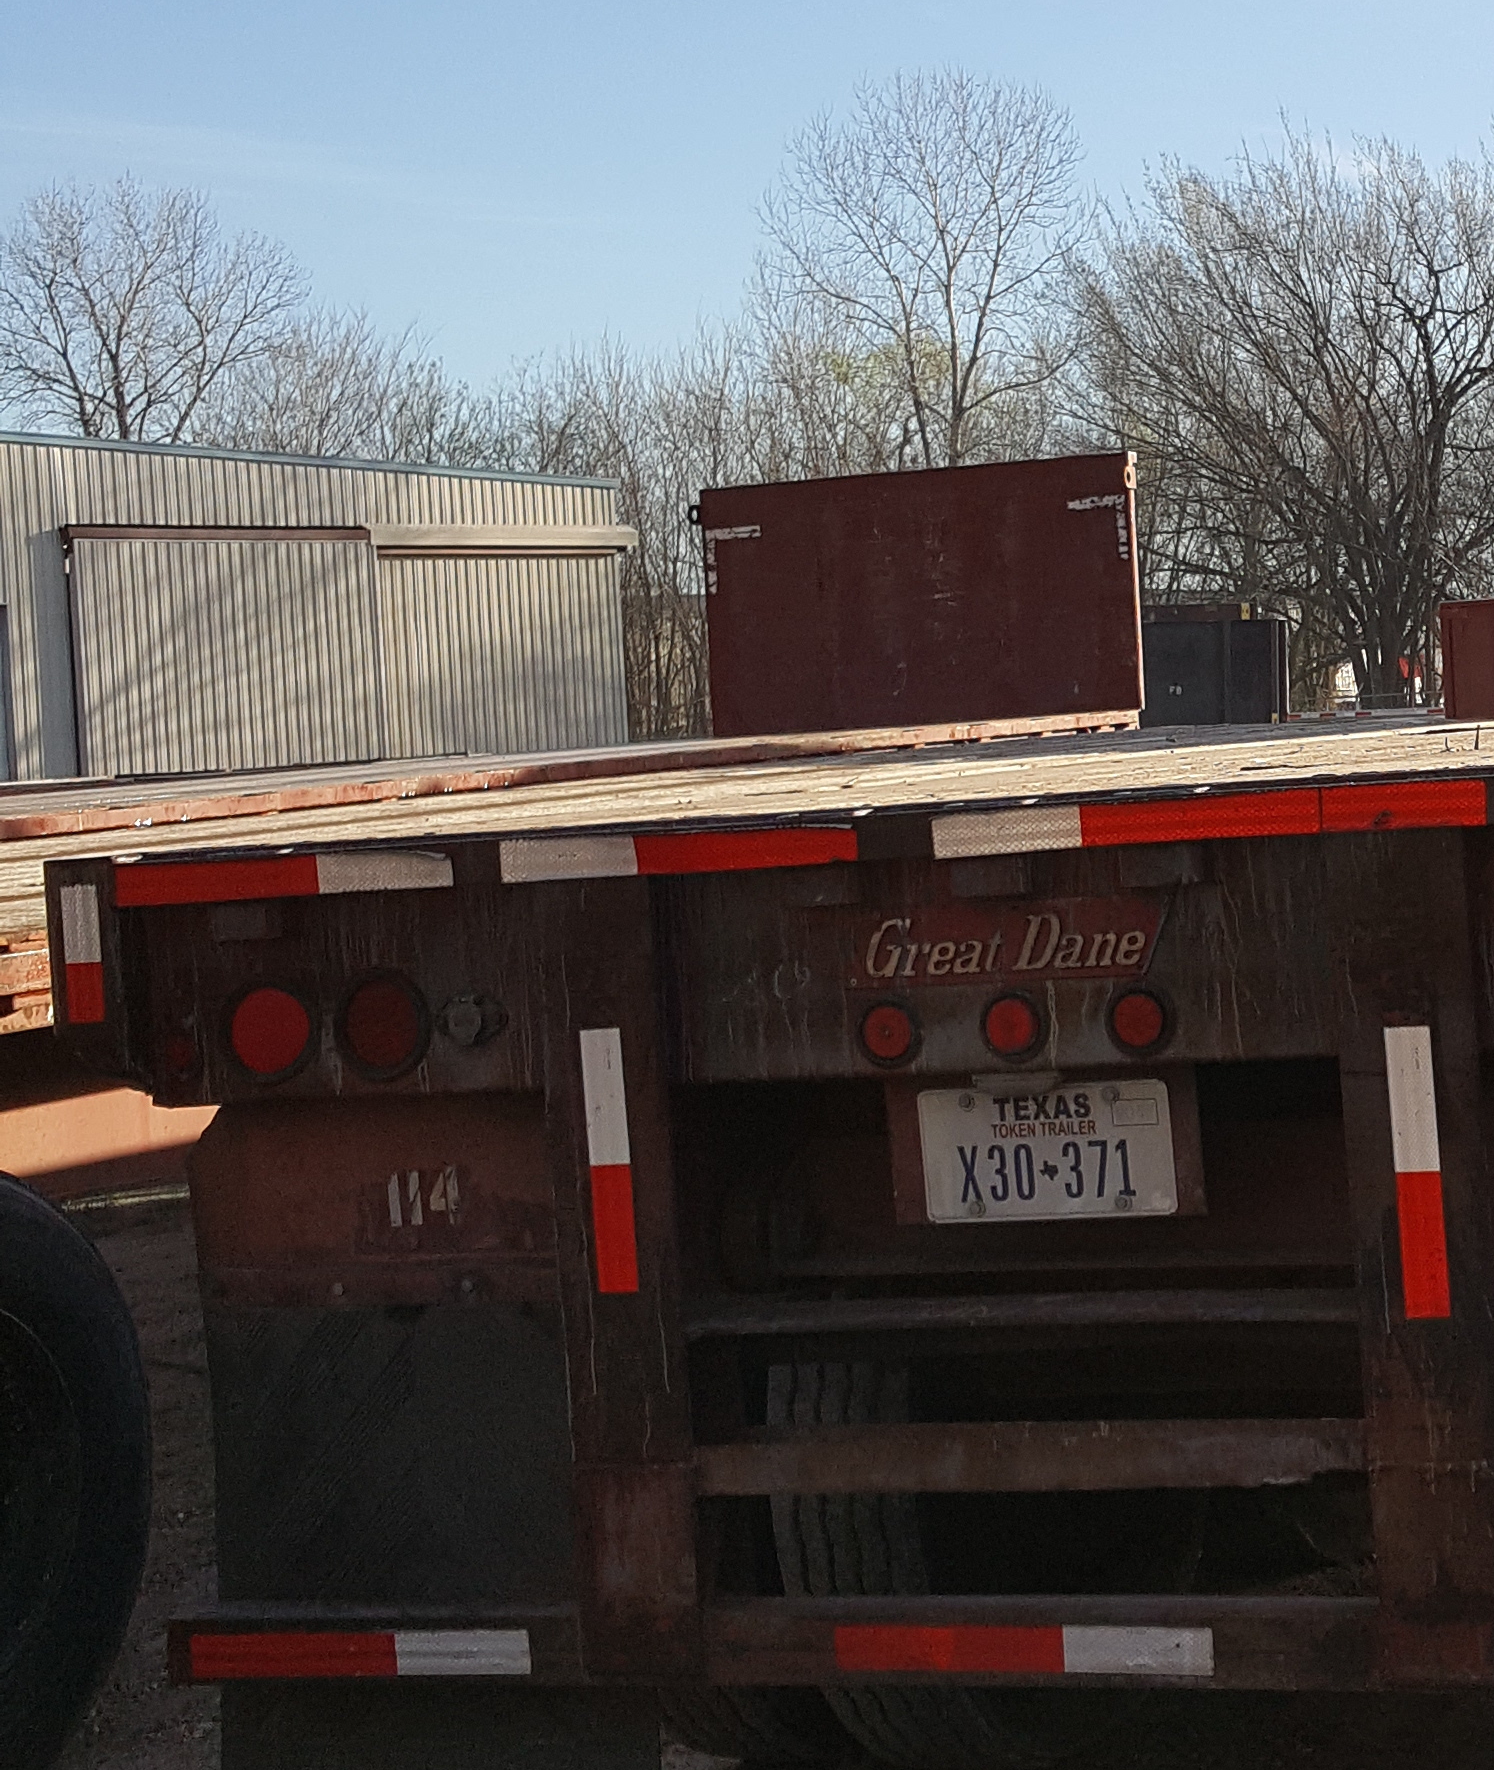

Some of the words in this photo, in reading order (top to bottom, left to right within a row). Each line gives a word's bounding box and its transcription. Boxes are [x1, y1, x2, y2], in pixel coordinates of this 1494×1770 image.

[865, 918, 1000, 979] Great
[1013, 914, 1146, 971] Dane
[992, 1093, 1092, 1123] TEXAS
[990, 1123, 1037, 1140] TOKEN
[1040, 1119, 1098, 1137] TRAILER
